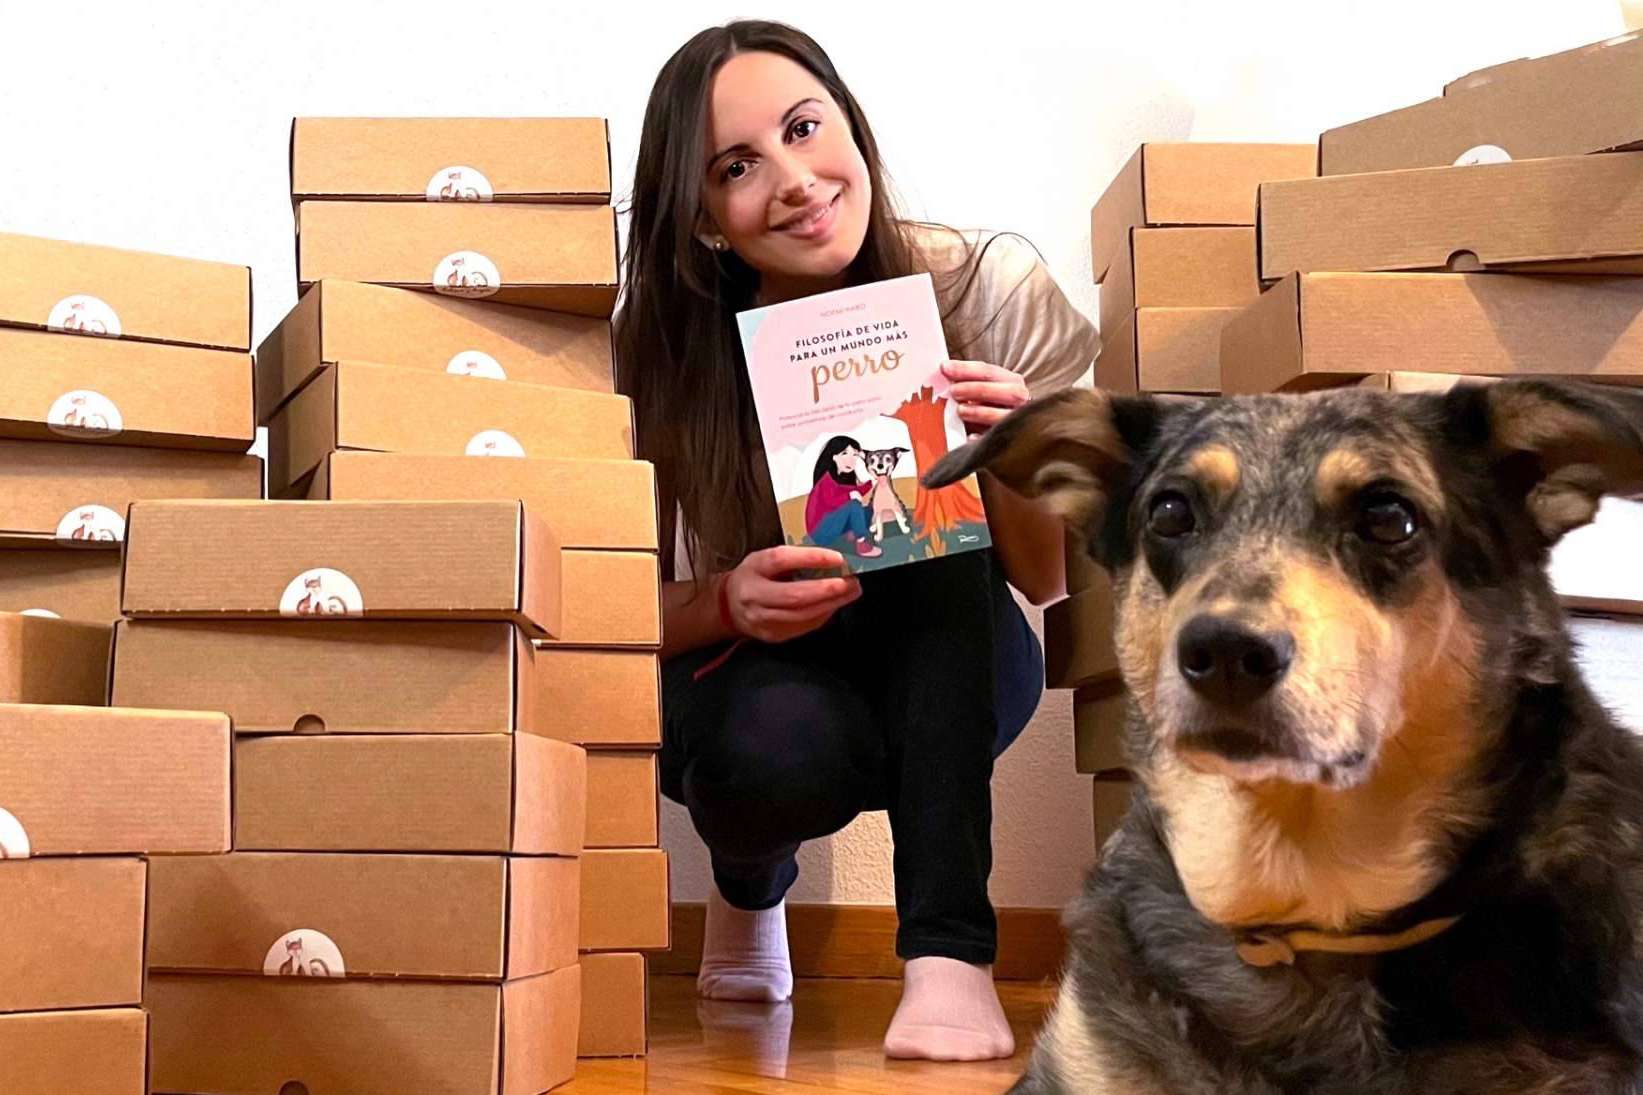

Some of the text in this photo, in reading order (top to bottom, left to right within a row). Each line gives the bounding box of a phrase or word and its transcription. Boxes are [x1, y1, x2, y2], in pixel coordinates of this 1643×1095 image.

[790, 331, 908, 362] PARA UN MUNDO MÁS
[796, 319, 899, 348] FILOSOFÍA DE VIDA
[811, 350, 905, 404] perro
